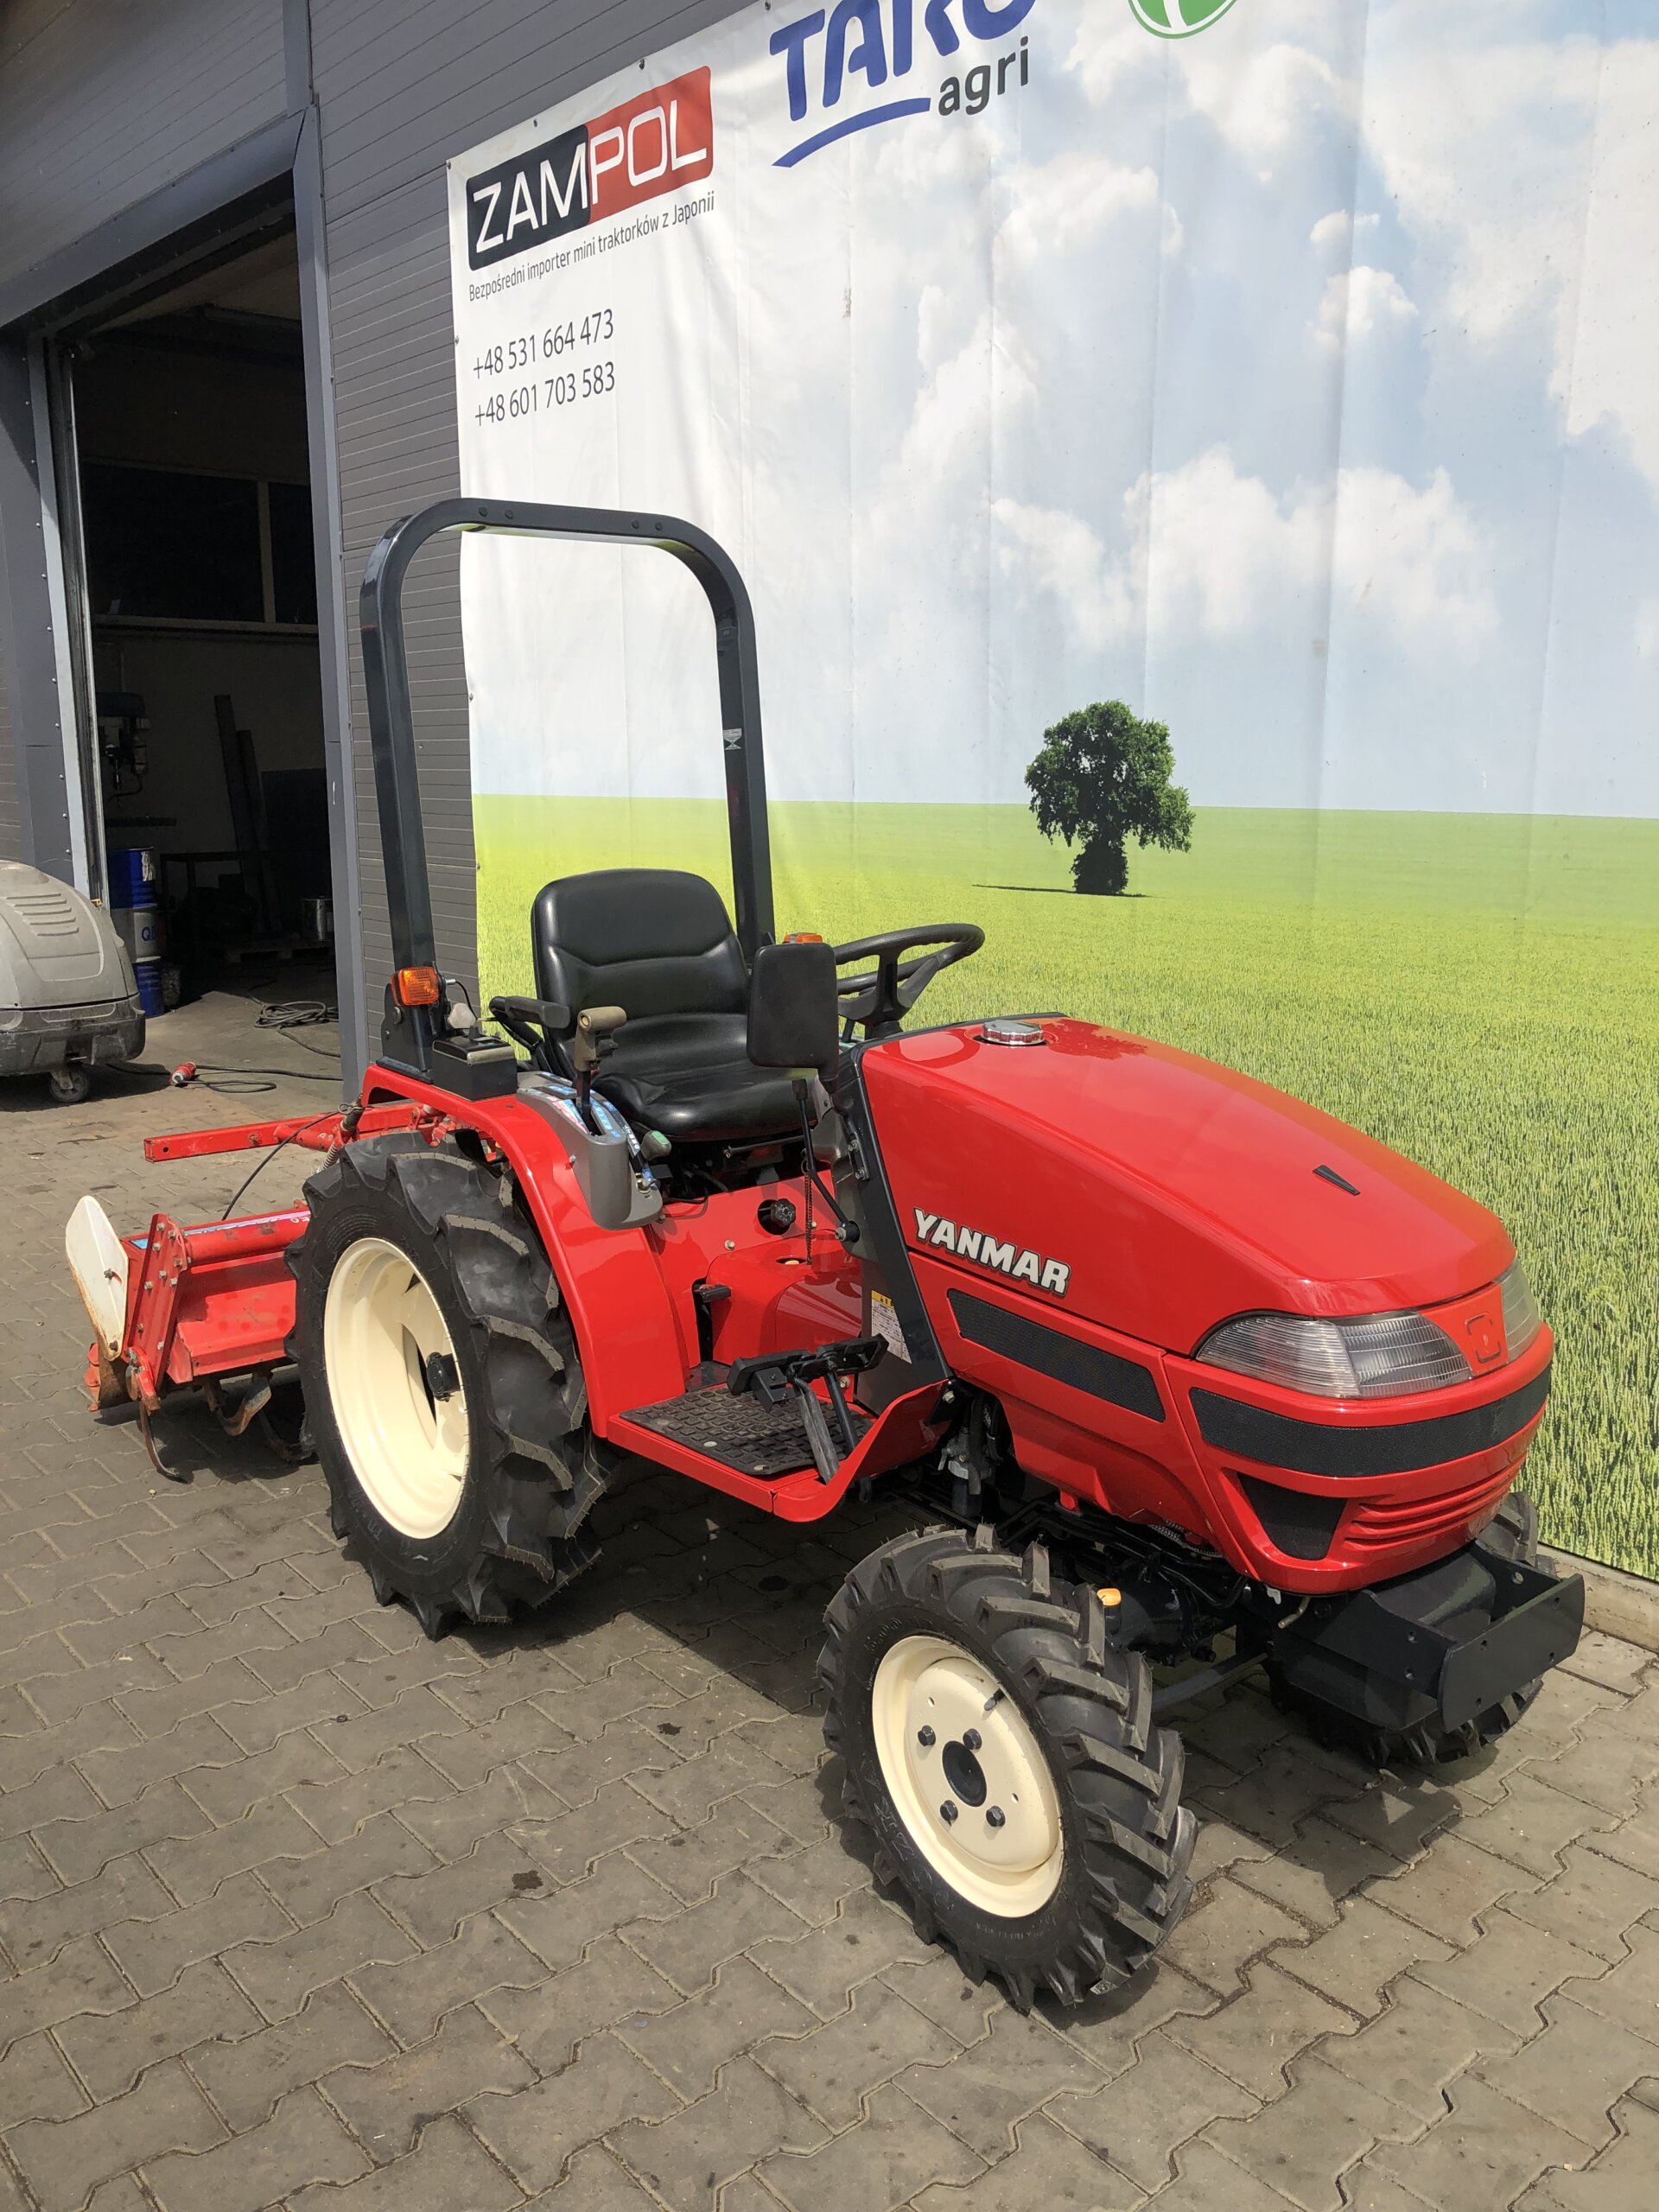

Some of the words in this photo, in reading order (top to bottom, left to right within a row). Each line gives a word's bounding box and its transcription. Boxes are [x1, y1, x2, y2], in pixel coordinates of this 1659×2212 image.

[938, 35, 1028, 116] agri
[473, 99, 707, 253] ZAMPOL
[468, 264, 525, 302] Bezpośredni
[527, 250, 571, 281] importer
[574, 236, 595, 264] mini
[598, 214, 659, 253] traktorków
[662, 212, 669, 228] z
[672, 190, 715, 226] Japonii
[474, 346, 504, 379] +48
[508, 334, 536, 370] 531
[543, 321, 575, 359] 664
[580, 308, 613, 346] 473
[475, 394, 505, 427] +48
[510, 384, 537, 418] 601
[544, 372, 576, 409] 703
[582, 361, 615, 398] 583
[913, 1206, 1071, 1295] YANMAR
